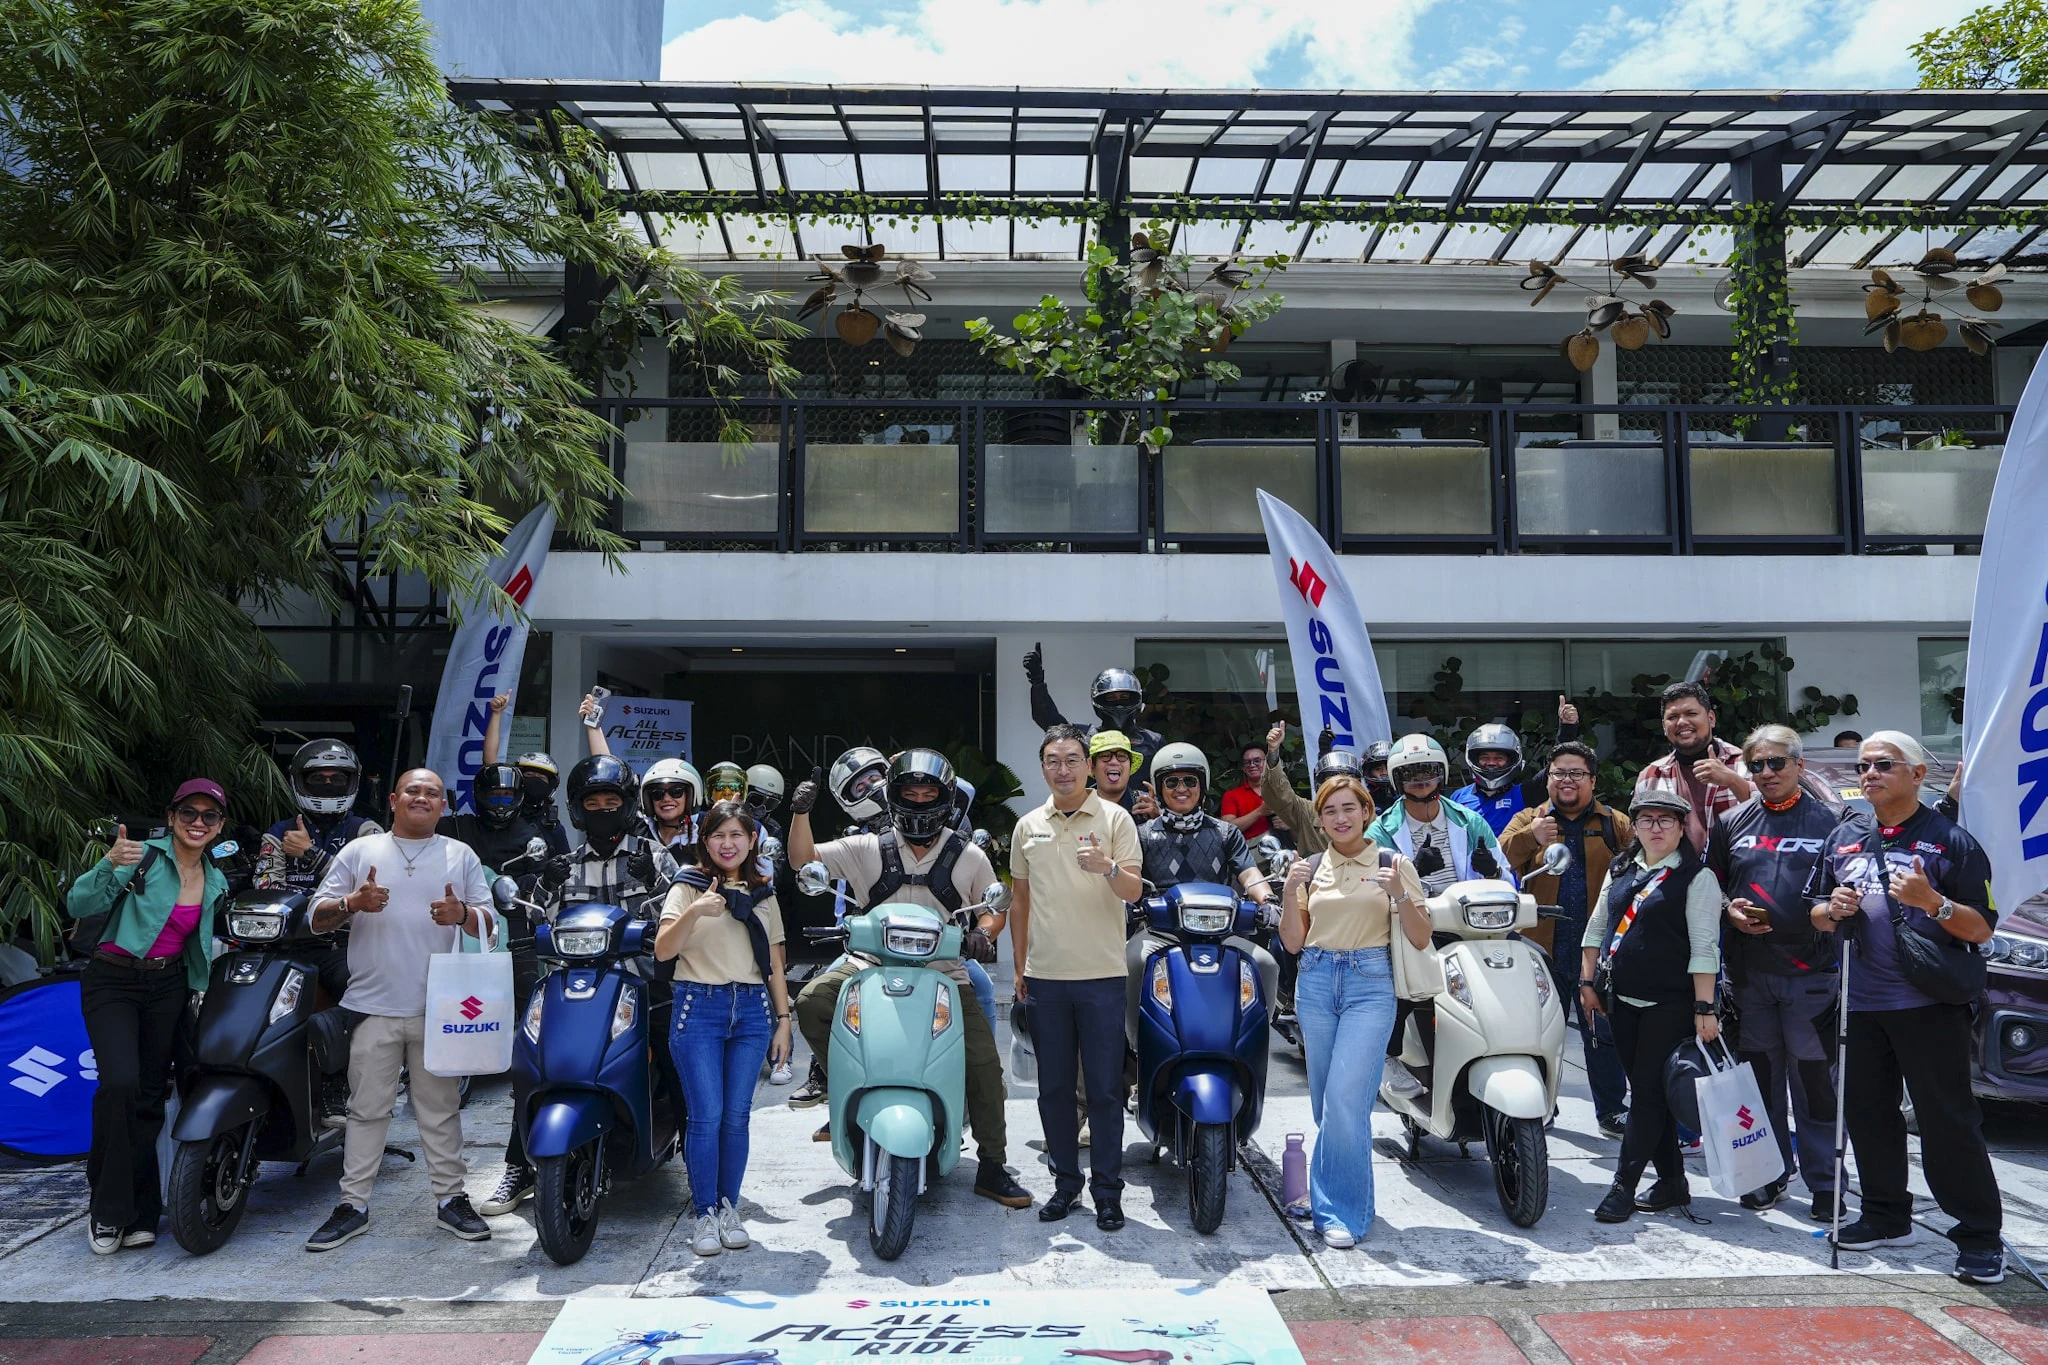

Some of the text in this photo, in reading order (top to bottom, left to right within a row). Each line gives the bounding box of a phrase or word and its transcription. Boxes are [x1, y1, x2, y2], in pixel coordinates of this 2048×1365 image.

[633, 706, 671, 716] SUZUKI
[634, 719, 659, 730] ALL
[630, 740, 663, 750] RIDE
[1729, 834, 1825, 854] AXOR
[442, 1021, 500, 1034] SUZUKI
[1731, 1127, 1768, 1150] SUZUKI
[879, 1299, 990, 1308] SUZUKI
[870, 1313, 964, 1326] ALL
[851, 1340, 984, 1356] RIDE
